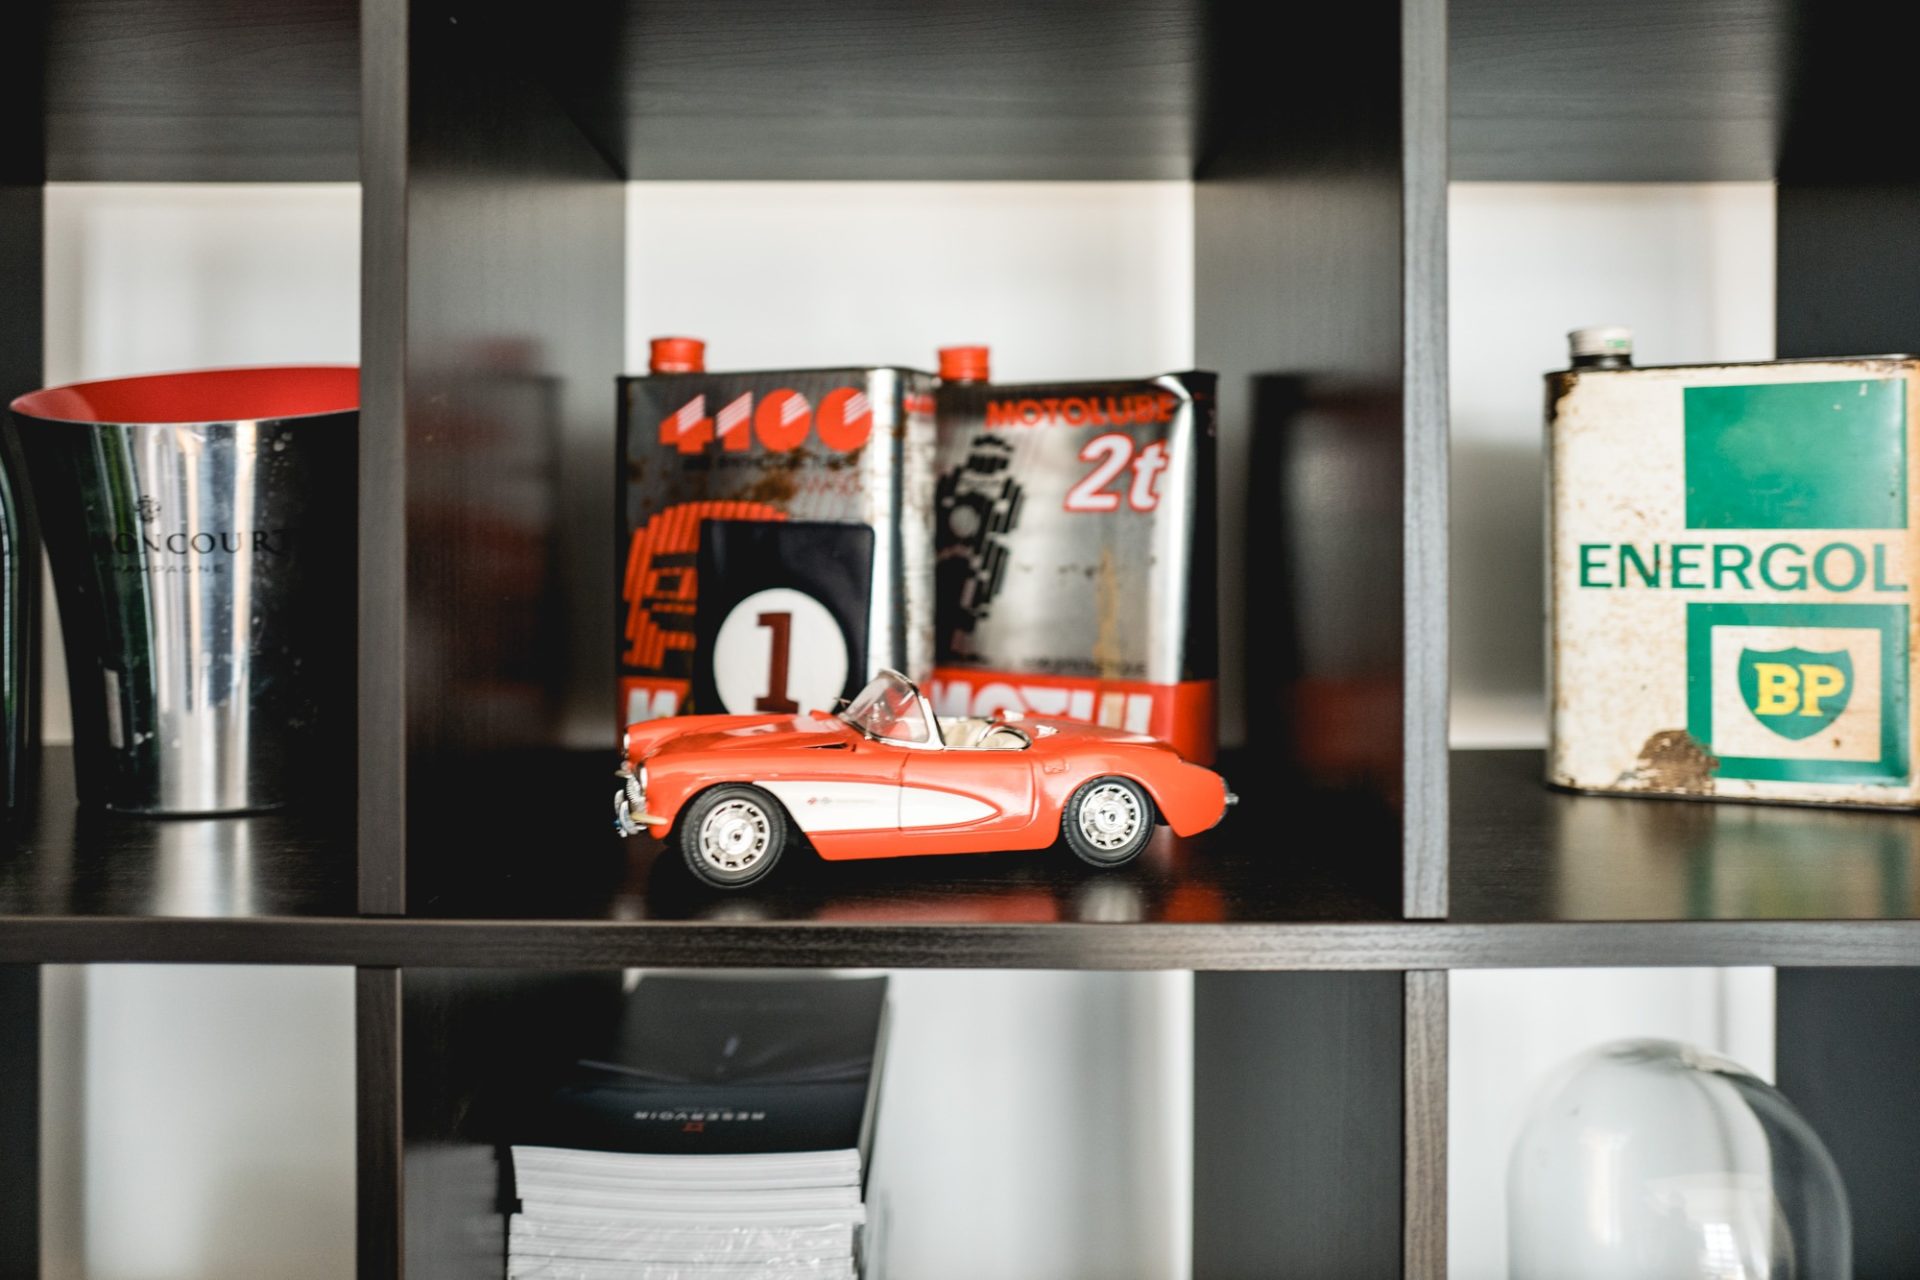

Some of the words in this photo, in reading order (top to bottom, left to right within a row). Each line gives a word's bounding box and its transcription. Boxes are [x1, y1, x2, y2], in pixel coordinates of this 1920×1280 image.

[659, 387, 873, 455] 4100
[985, 394, 1177, 430] MOTOLUBE
[1063, 432, 1169, 513] 2t
[1579, 542, 1909, 593] ENERGOL
[755, 612, 799, 715] 1
[1752, 662, 1846, 717] BP
